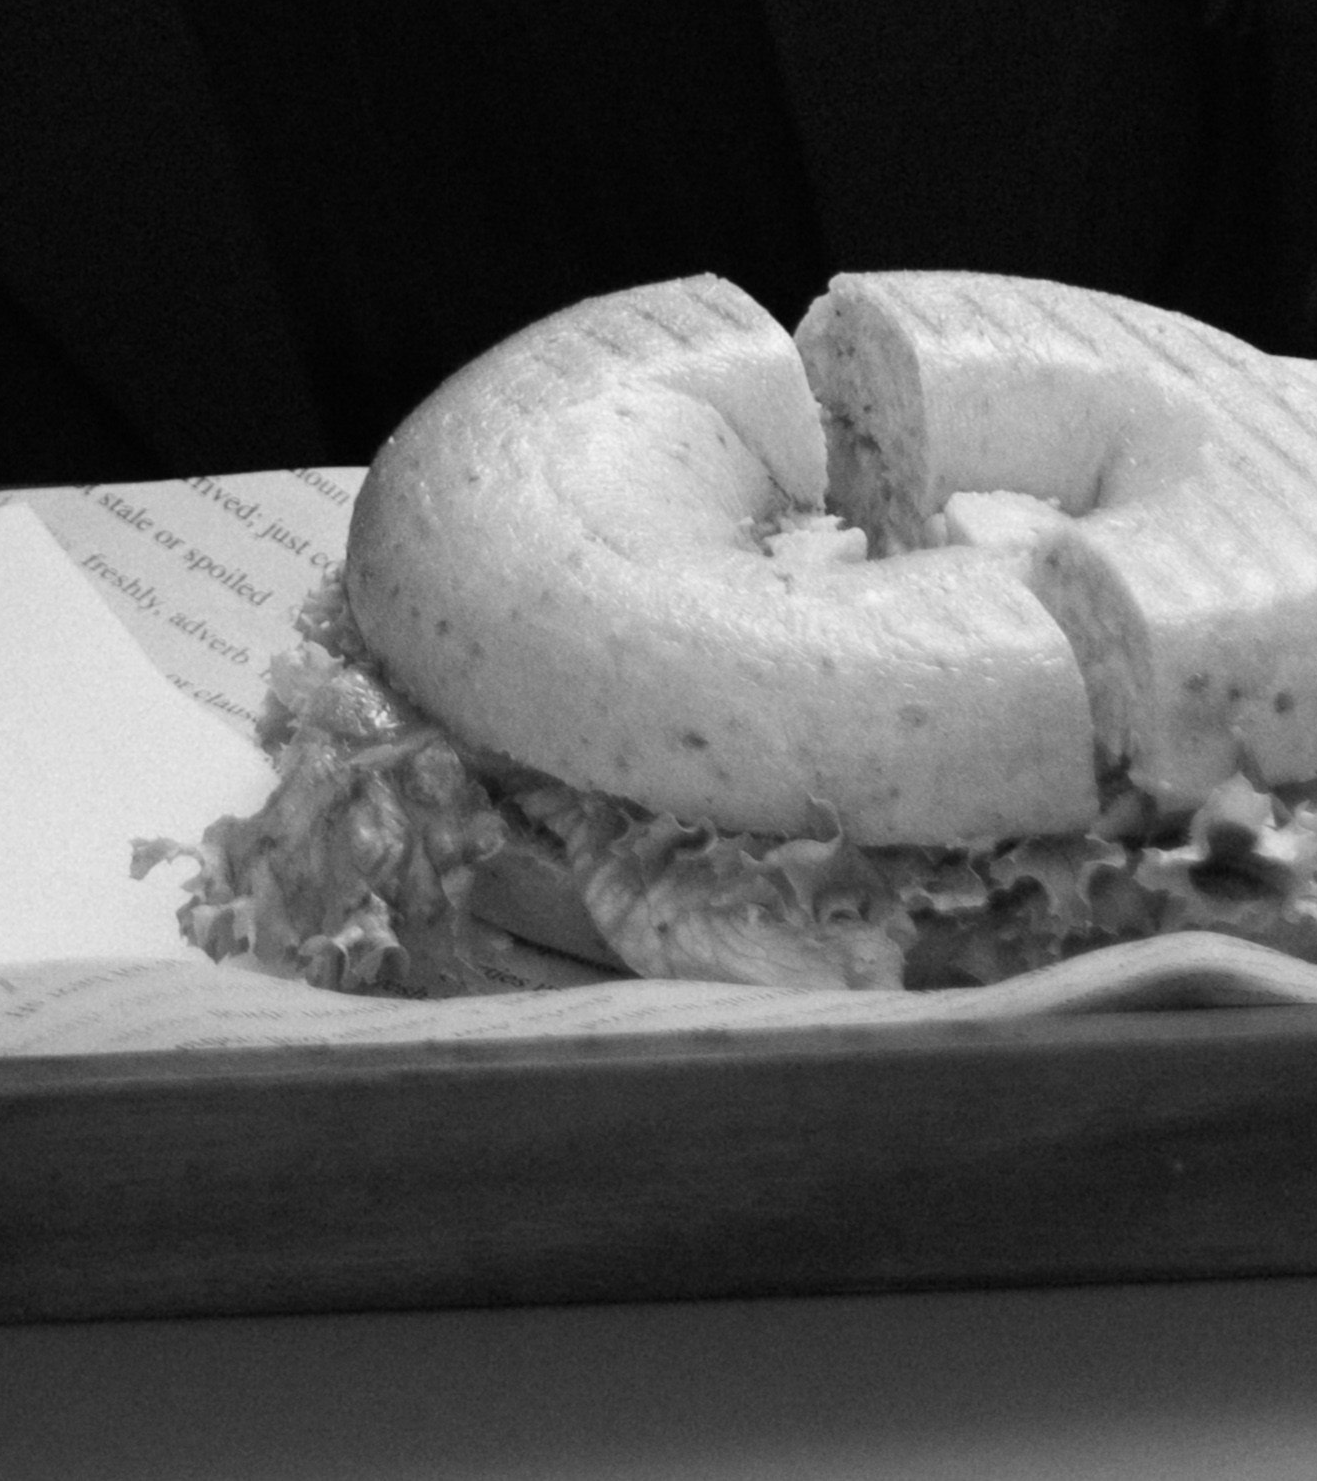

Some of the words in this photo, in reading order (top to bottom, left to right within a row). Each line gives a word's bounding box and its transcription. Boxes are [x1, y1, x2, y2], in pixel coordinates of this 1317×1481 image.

[98, 492, 154, 533] stale
[154, 528, 186, 550] or
[183, 546, 275, 607] spoiled
[168, 611, 251, 666] adverb
